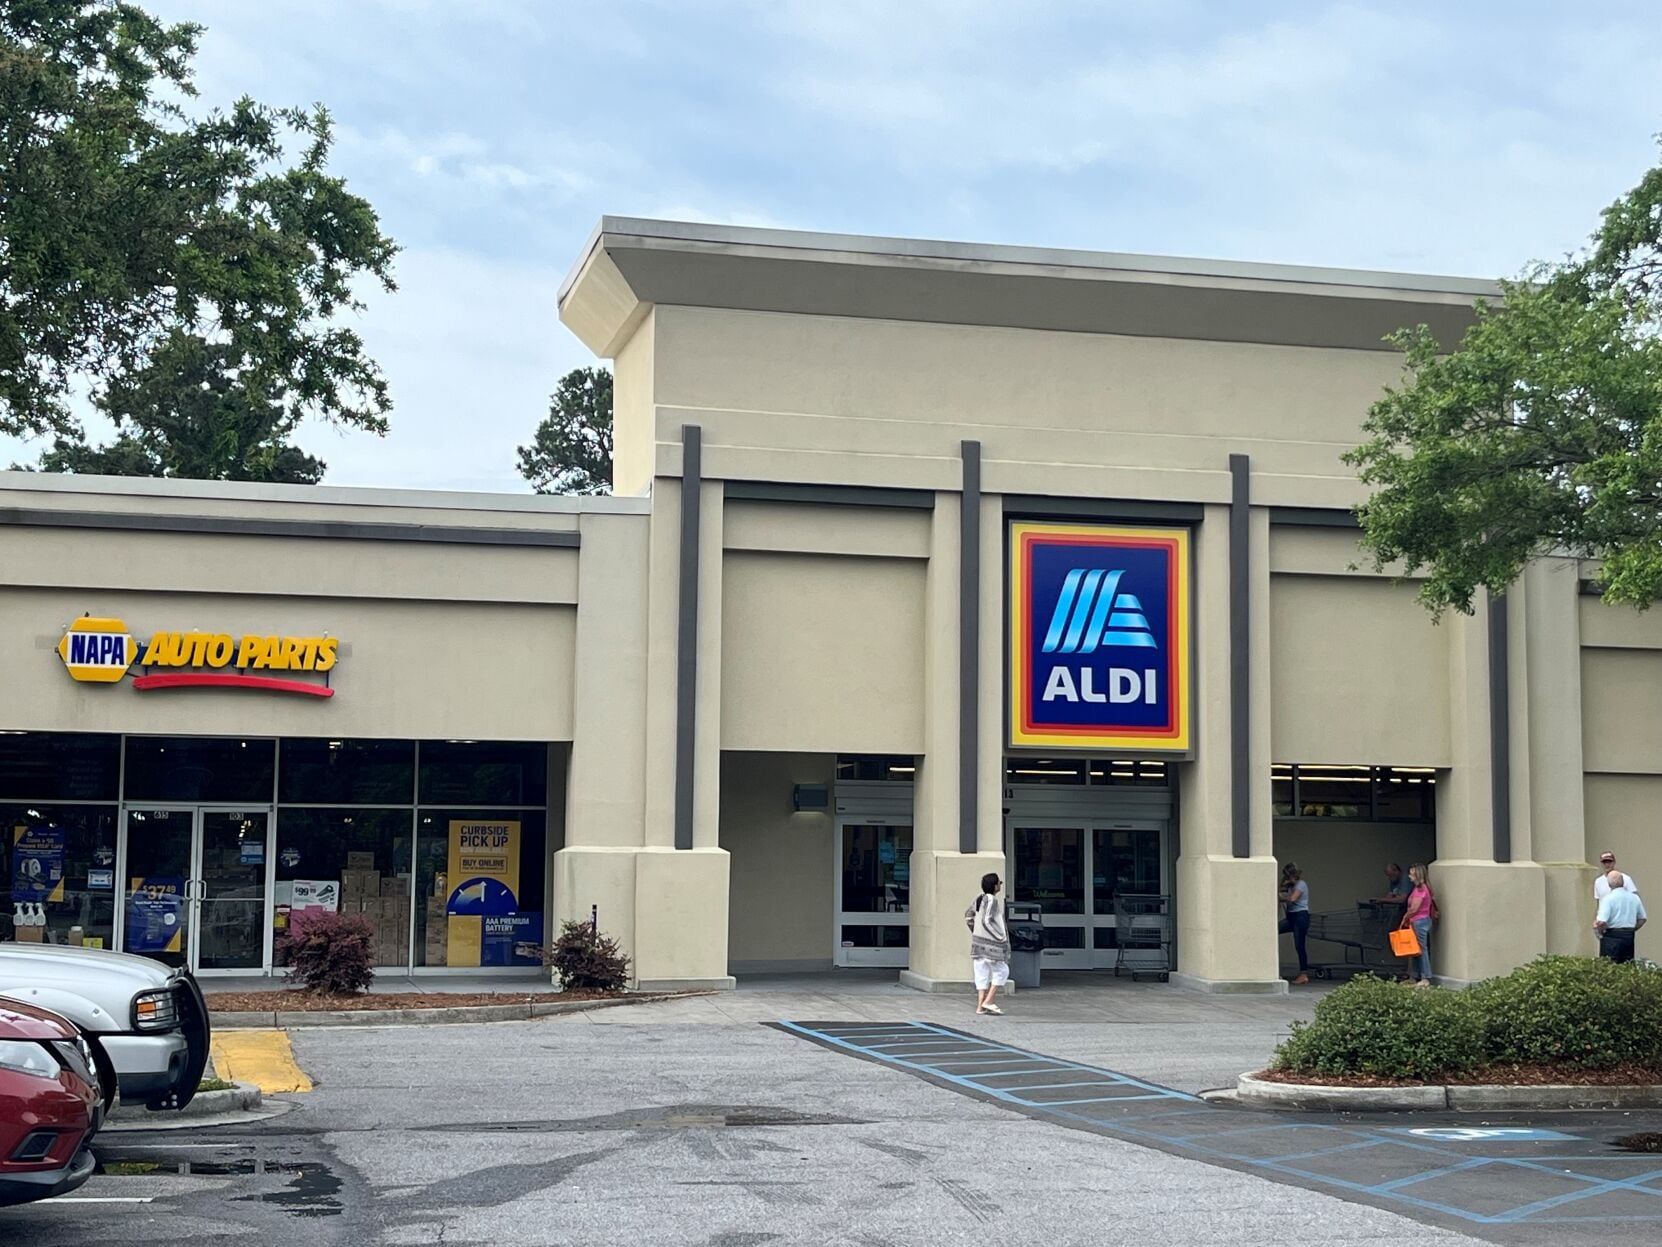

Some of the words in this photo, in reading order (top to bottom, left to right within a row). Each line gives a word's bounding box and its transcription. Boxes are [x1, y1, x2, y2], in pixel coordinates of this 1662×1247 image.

[71, 634, 125, 666] NAPA
[142, 632, 235, 668] AUTO
[235, 635, 340, 672] PARTS
[1042, 666, 1157, 705] ALDI
[460, 825, 509, 836] CURBSIDE
[460, 835, 489, 848] PICK
[492, 836, 509, 848] UP
[462, 858, 477, 867] BUY
[478, 858, 505, 868] ONLINE
